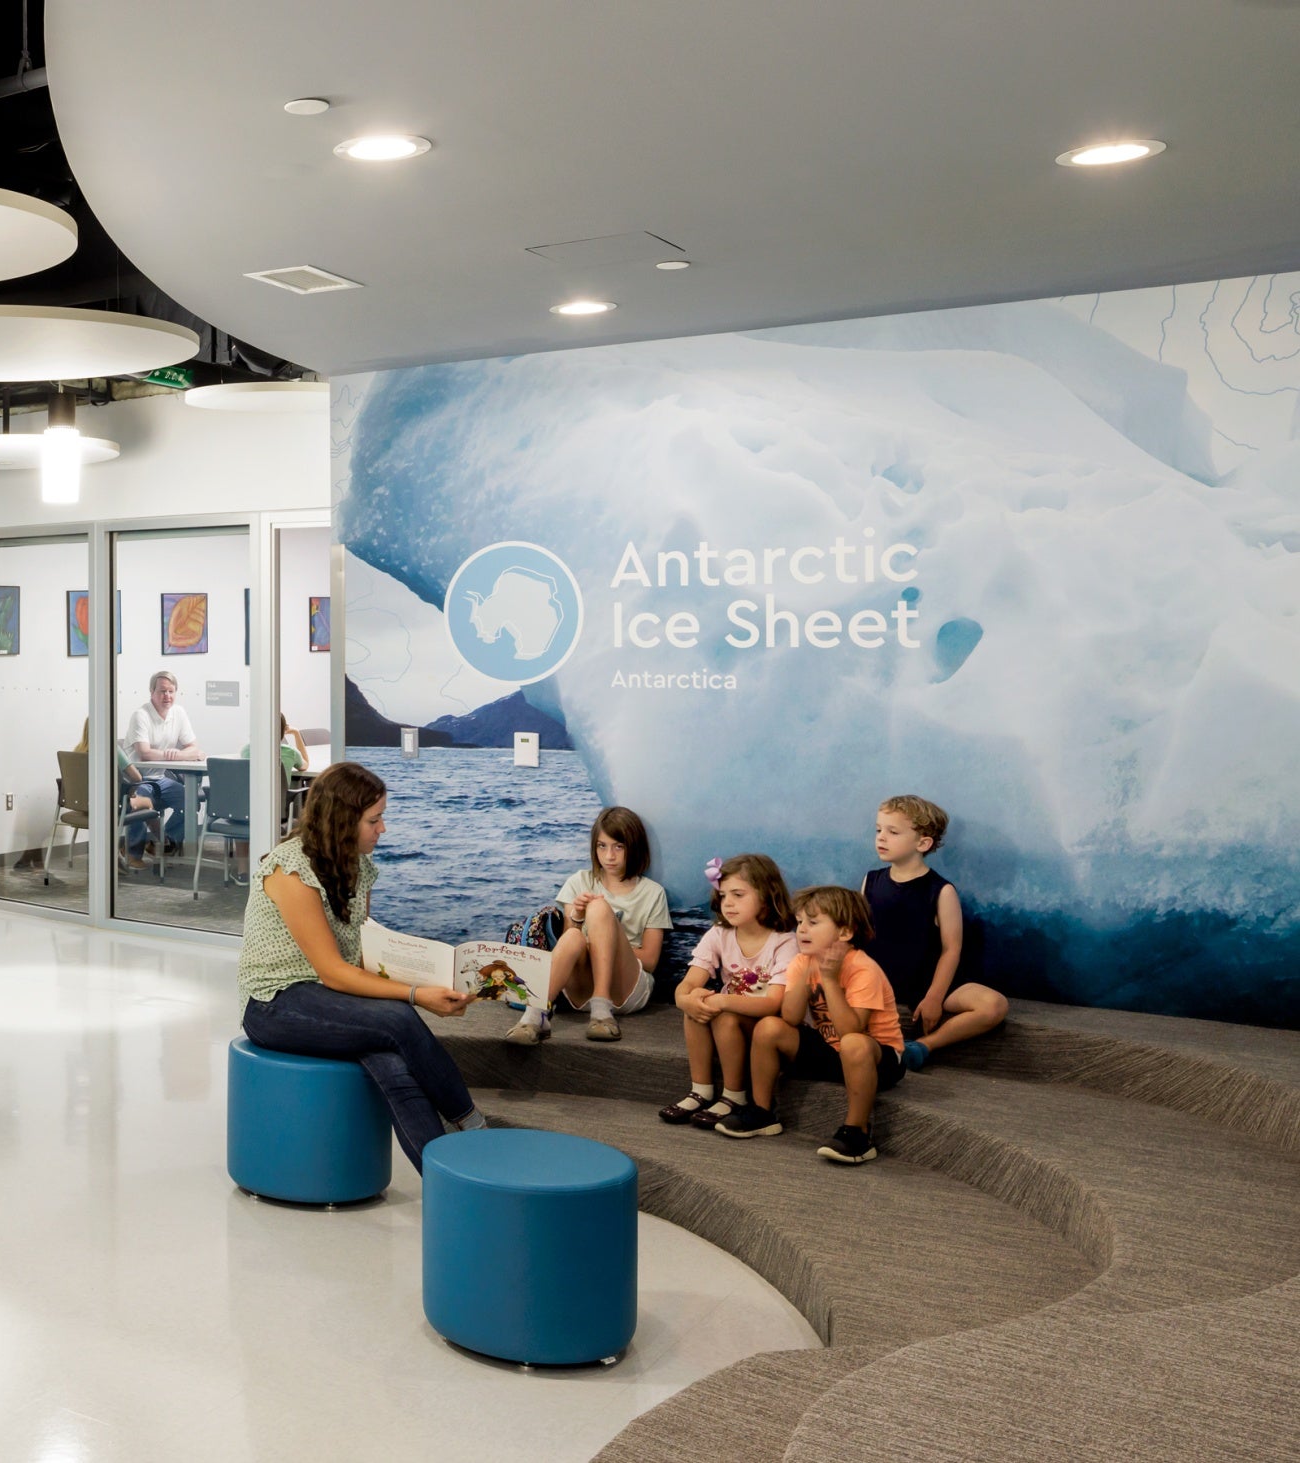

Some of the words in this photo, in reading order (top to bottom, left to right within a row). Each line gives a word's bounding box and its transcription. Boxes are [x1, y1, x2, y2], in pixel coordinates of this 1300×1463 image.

[610, 527, 919, 588] Antarctic
[613, 602, 700, 649] Ice
[725, 593, 921, 649] Sheet
[610, 668, 738, 690] Antarctica
[477, 943, 527, 959] Perfect
